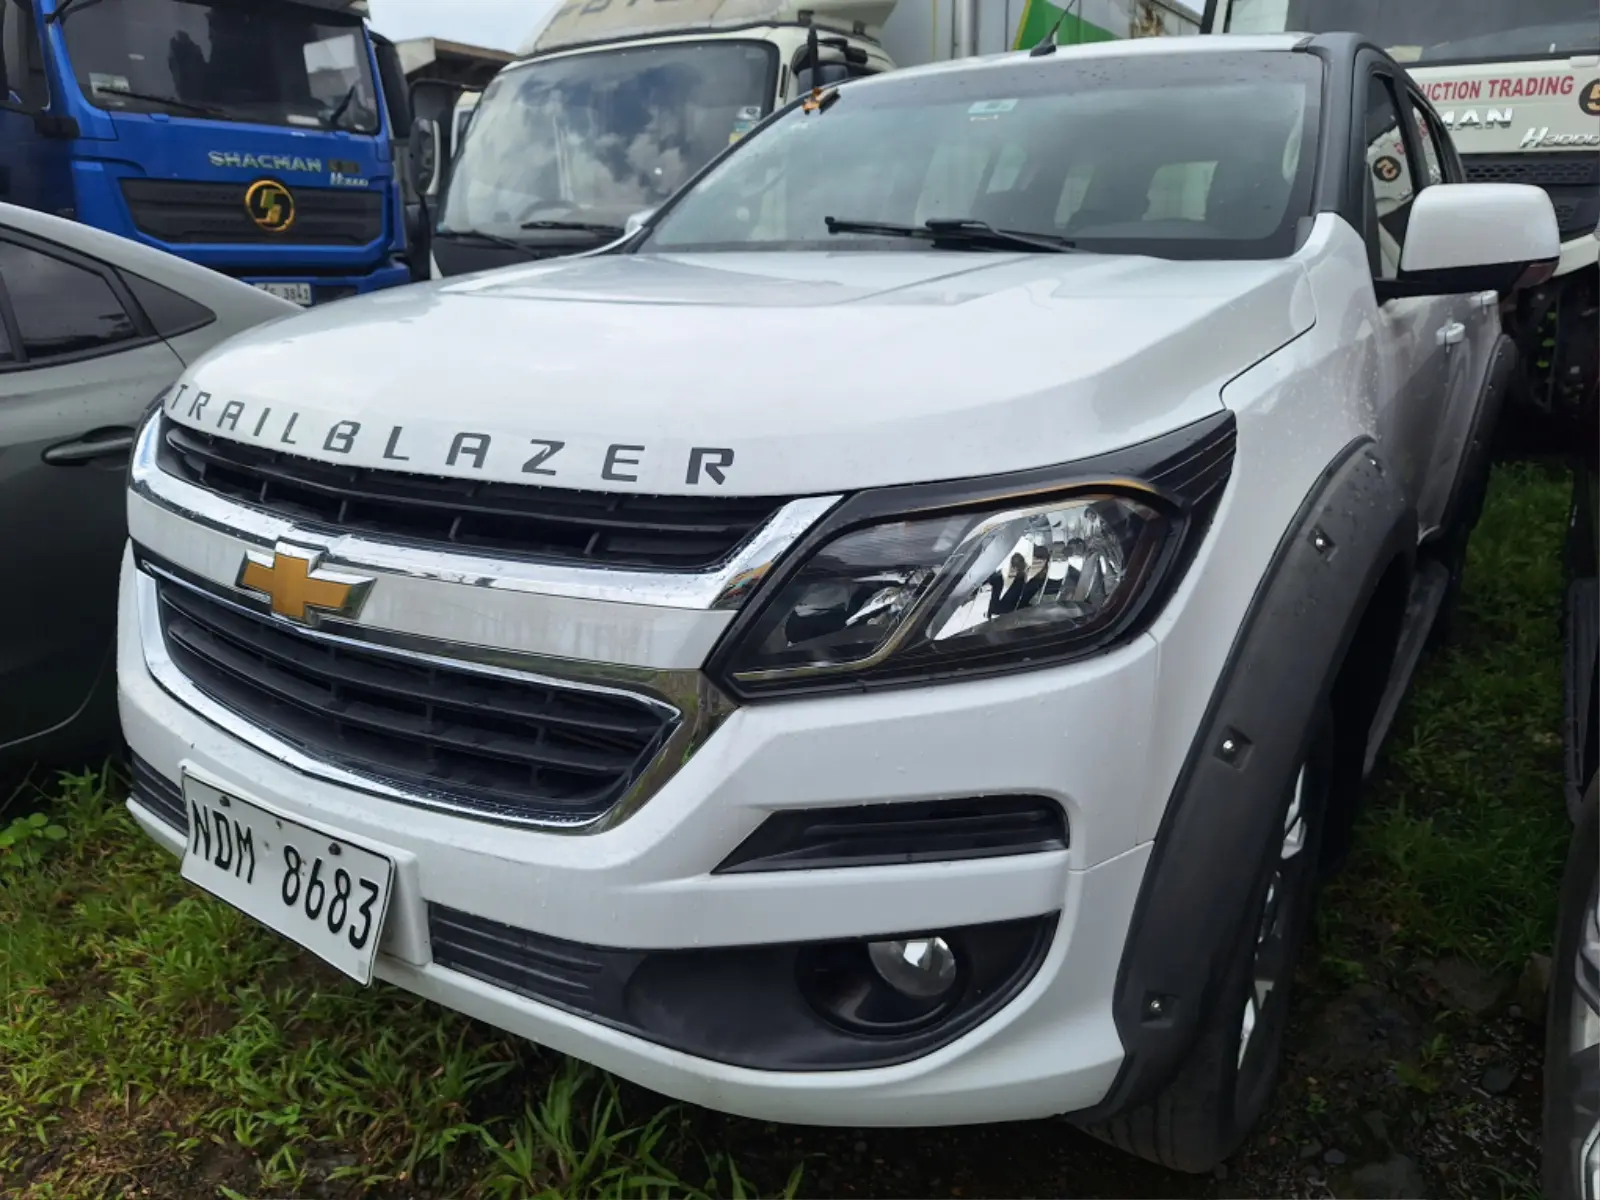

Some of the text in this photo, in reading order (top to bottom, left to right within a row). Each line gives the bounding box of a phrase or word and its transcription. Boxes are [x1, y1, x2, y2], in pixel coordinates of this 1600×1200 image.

[1489, 75, 1574, 98] TRADING
[1519, 127, 1600, 148] H3000
[208, 151, 321, 172] SHACMAN
[171, 384, 734, 485] TRAILBLAZER
[192, 799, 379, 949] NDM 8683
